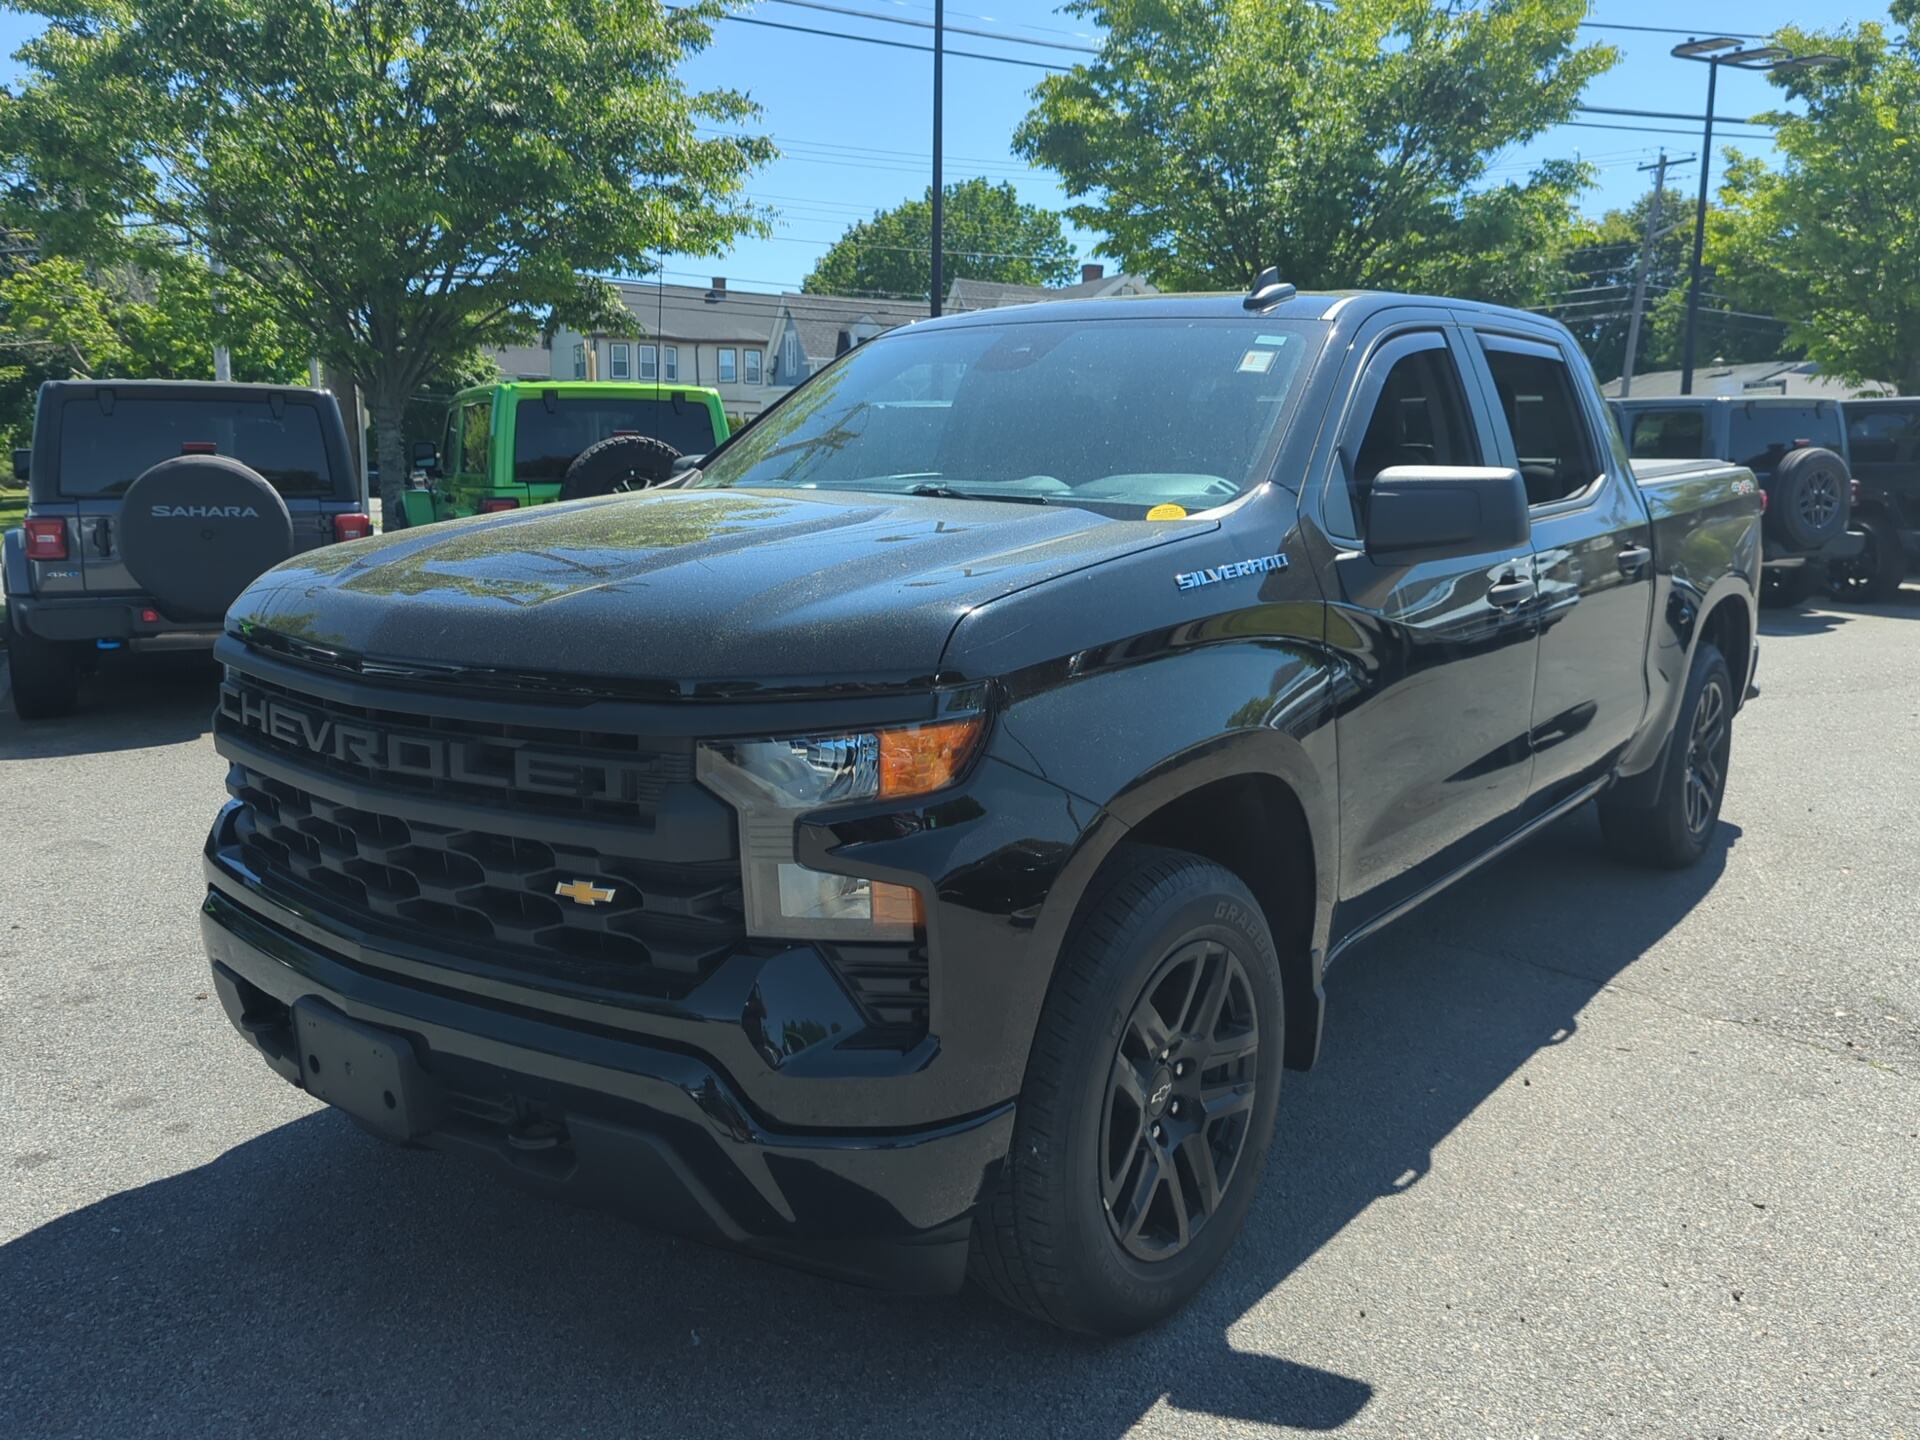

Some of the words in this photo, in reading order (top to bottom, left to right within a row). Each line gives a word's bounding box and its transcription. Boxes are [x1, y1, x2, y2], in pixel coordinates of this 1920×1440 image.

[151, 505, 259, 517] SAHARA
[1175, 553, 1289, 590] SILVERADO
[219, 681, 655, 799] CHEVROLET
[1214, 902, 1276, 982] GRABBER
